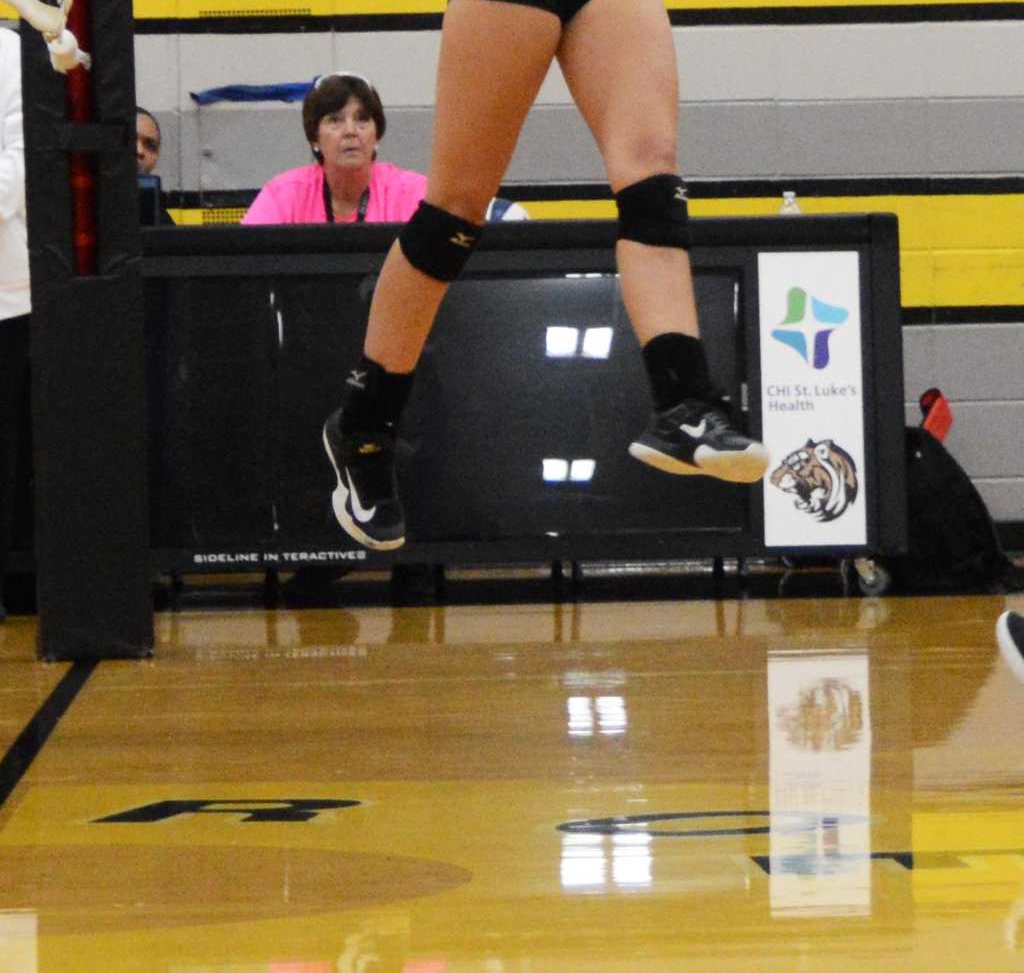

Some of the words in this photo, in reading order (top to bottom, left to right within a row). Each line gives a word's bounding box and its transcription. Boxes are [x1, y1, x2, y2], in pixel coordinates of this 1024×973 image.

[767, 385, 791, 397] CHI
[814, 383, 857, 397] Luke's
[768, 400, 815, 411] Health
[193, 553, 259, 563] SIDELINE
